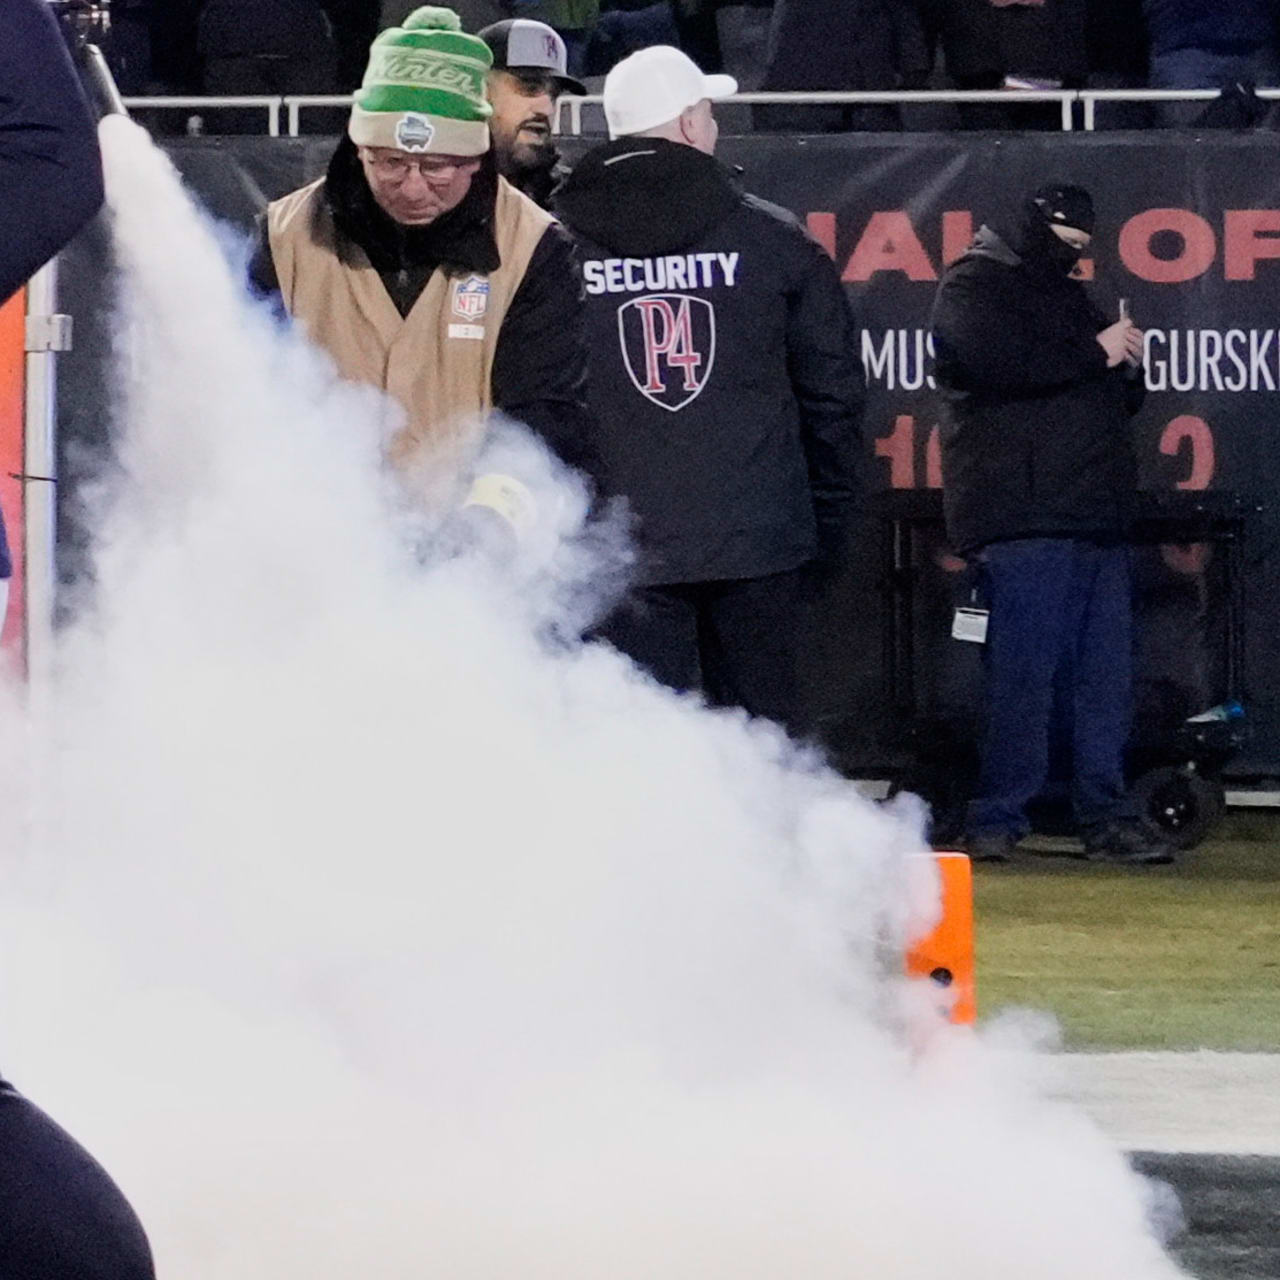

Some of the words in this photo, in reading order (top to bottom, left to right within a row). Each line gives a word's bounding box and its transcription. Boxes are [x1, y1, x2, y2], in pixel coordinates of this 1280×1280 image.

[583, 252, 739, 295] SECURITY
[1119, 208, 1280, 282] OF
[634, 298, 701, 393] P4
[1143, 328, 1280, 392] GURSK
